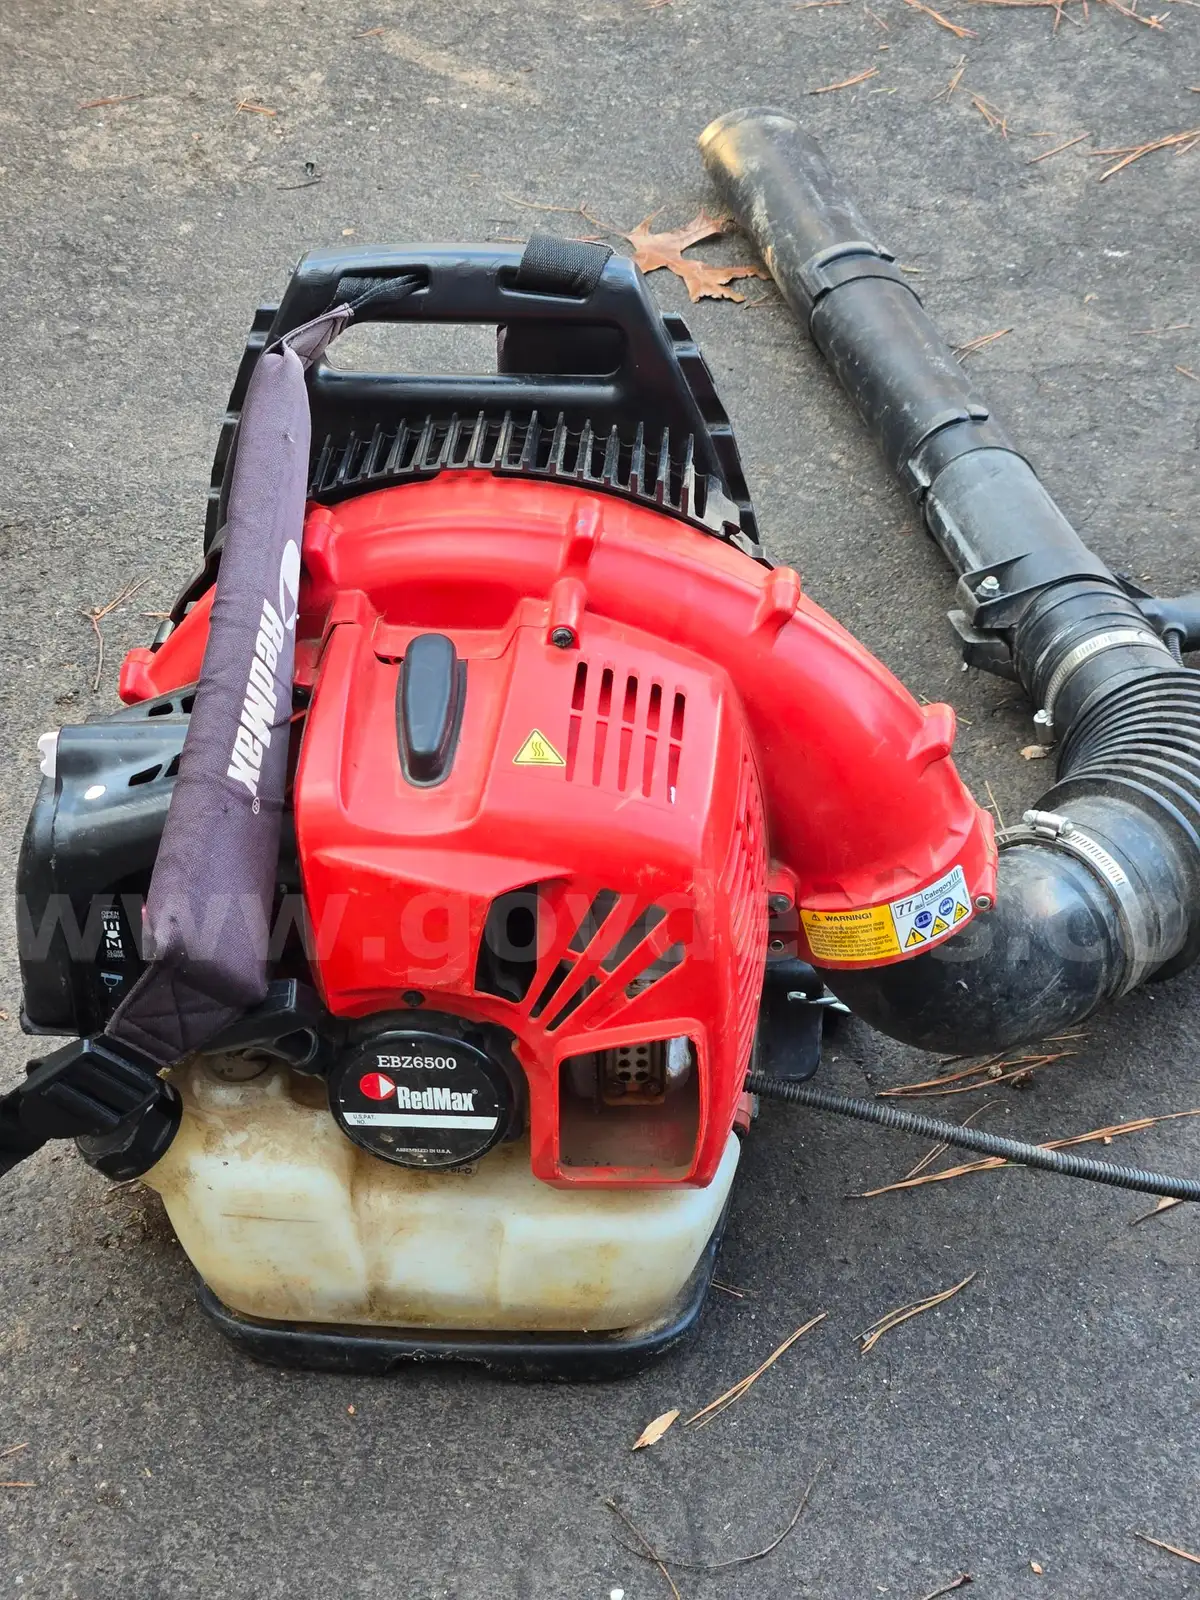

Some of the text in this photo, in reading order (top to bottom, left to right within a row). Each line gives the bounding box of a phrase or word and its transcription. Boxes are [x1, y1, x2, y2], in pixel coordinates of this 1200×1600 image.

[227, 599, 285, 797] RedMax
[924, 880, 951, 900] Category
[951, 870, 959, 882] III
[896, 900, 913, 915] 77
[824, 912, 872, 922] WARNING!
[376, 1055, 457, 1070] EBZ6500
